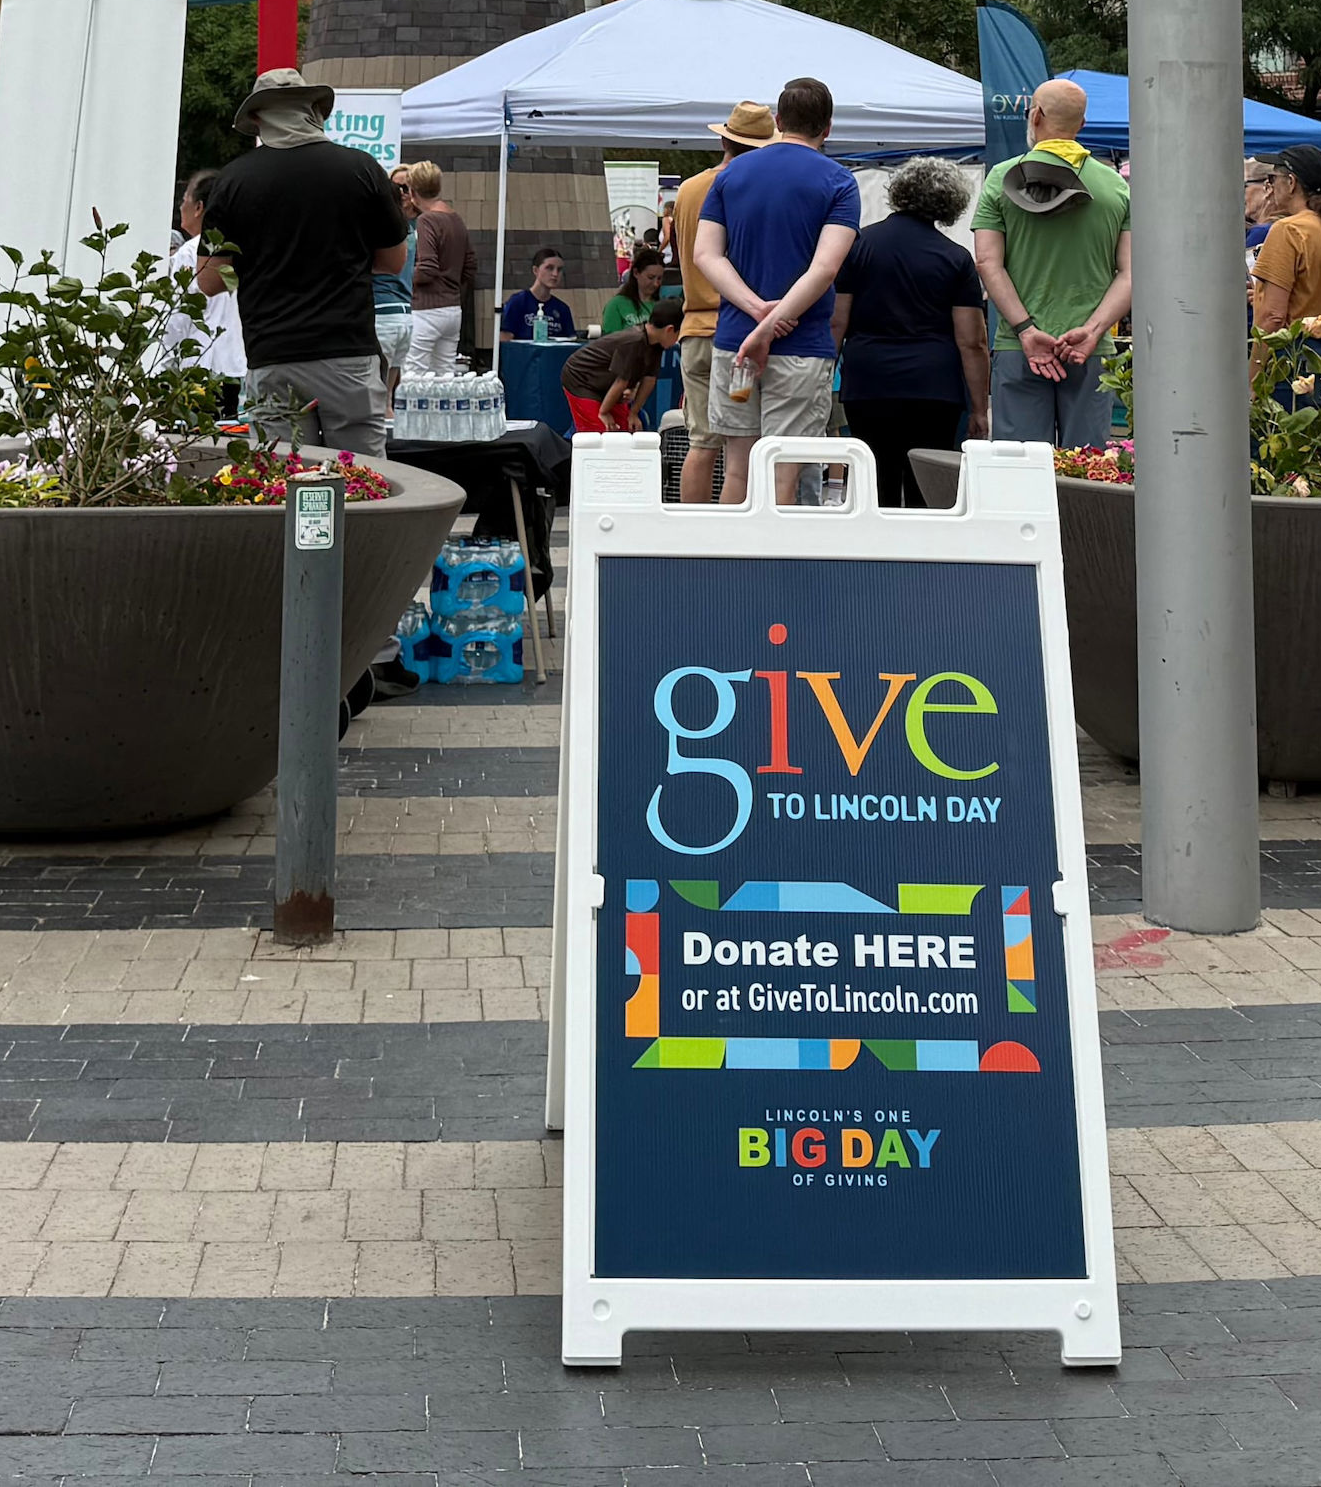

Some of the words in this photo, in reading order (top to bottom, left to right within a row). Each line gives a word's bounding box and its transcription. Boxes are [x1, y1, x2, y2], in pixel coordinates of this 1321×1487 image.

[646, 623, 1000, 855] give
[766, 793, 806, 820] TO
[814, 794, 937, 822] LINCOLN
[946, 796, 1002, 823] DAY
[683, 931, 839, 967] Donate
[854, 934, 977, 969] HERE
[681, 988, 709, 1011] or
[716, 985, 741, 1011] at
[748, 982, 979, 1014] GiveToLincoln.com
[765, 1109, 863, 1122] LINCOLN'S
[874, 1110, 911, 1123] ONE
[738, 1127, 827, 1168] BIG
[841, 1128, 942, 1169] DAY
[792, 1173, 815, 1187] OF
[824, 1174, 888, 1187] GIVING
